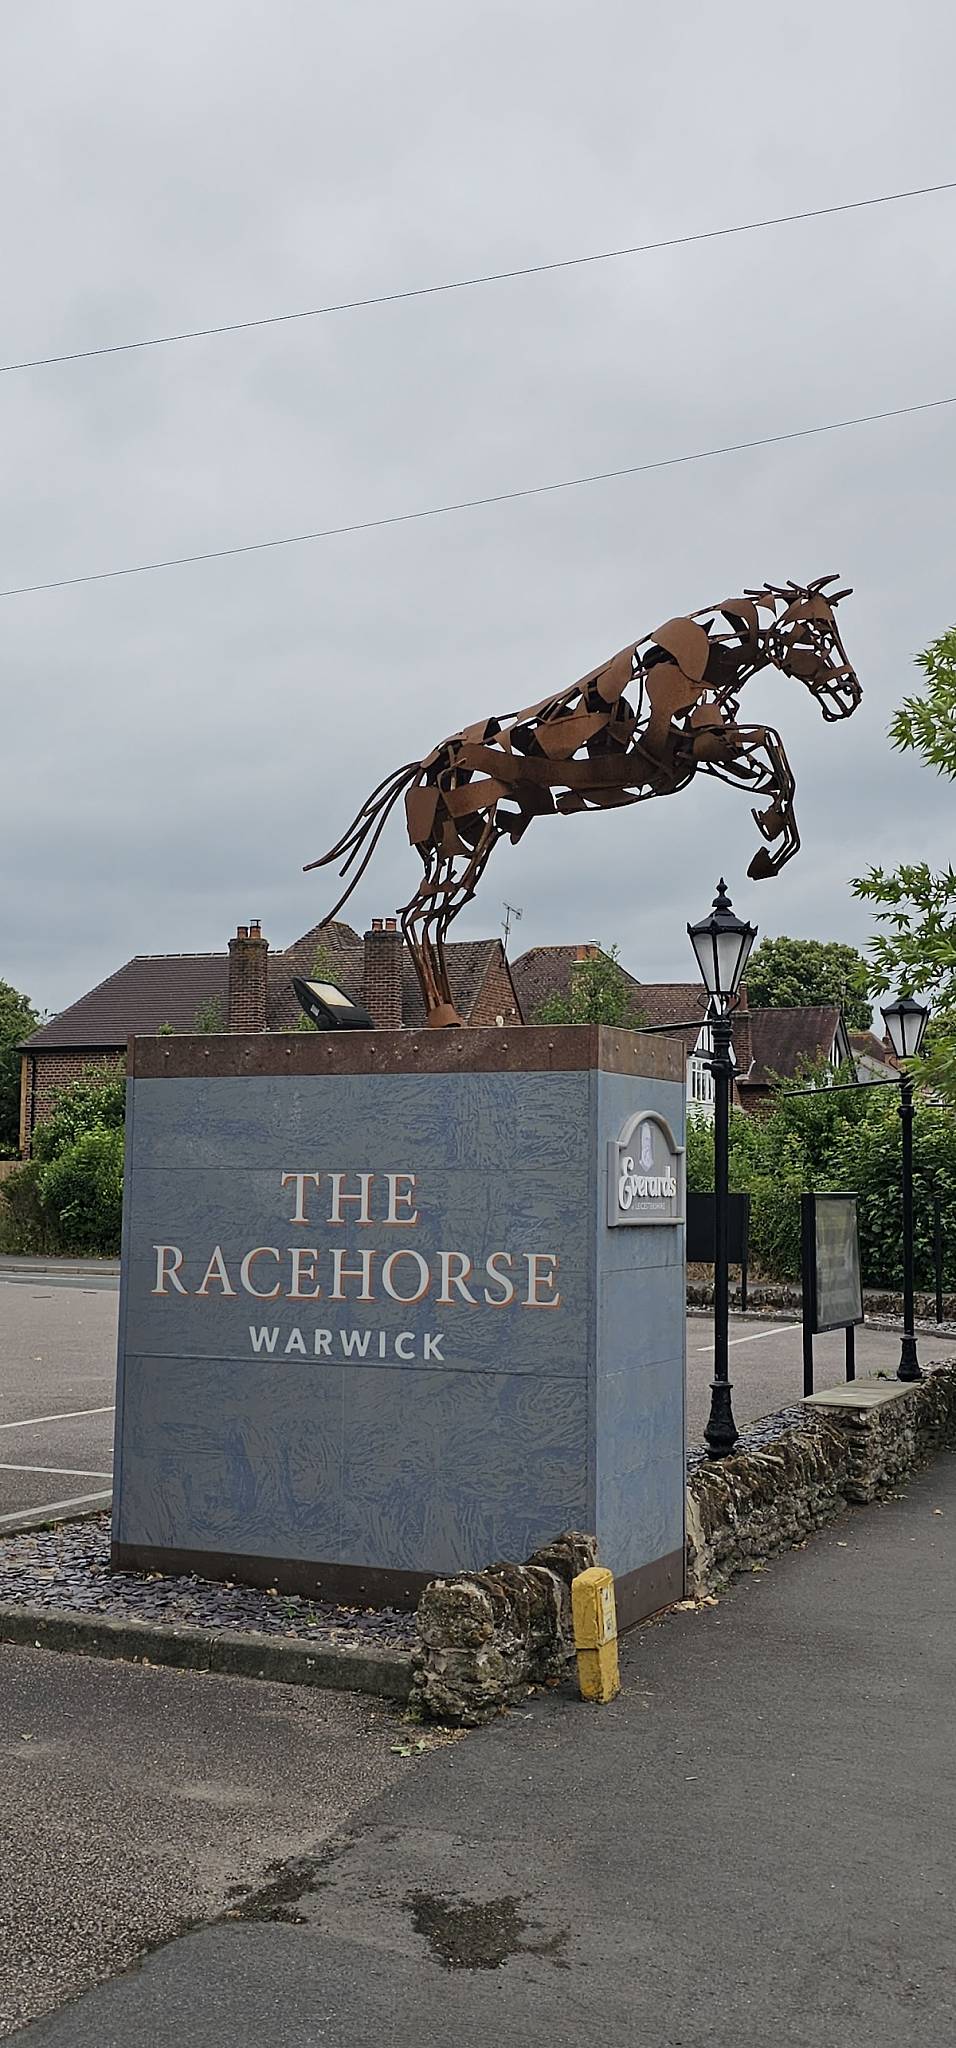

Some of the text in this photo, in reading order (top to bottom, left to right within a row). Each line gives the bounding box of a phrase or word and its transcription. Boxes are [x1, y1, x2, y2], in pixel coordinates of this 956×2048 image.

[281, 1171, 420, 1226] THE
[618, 1156, 677, 1210] Everards
[151, 1244, 562, 1309] RACEHORSE
[248, 1325, 446, 1361] WARWICK
